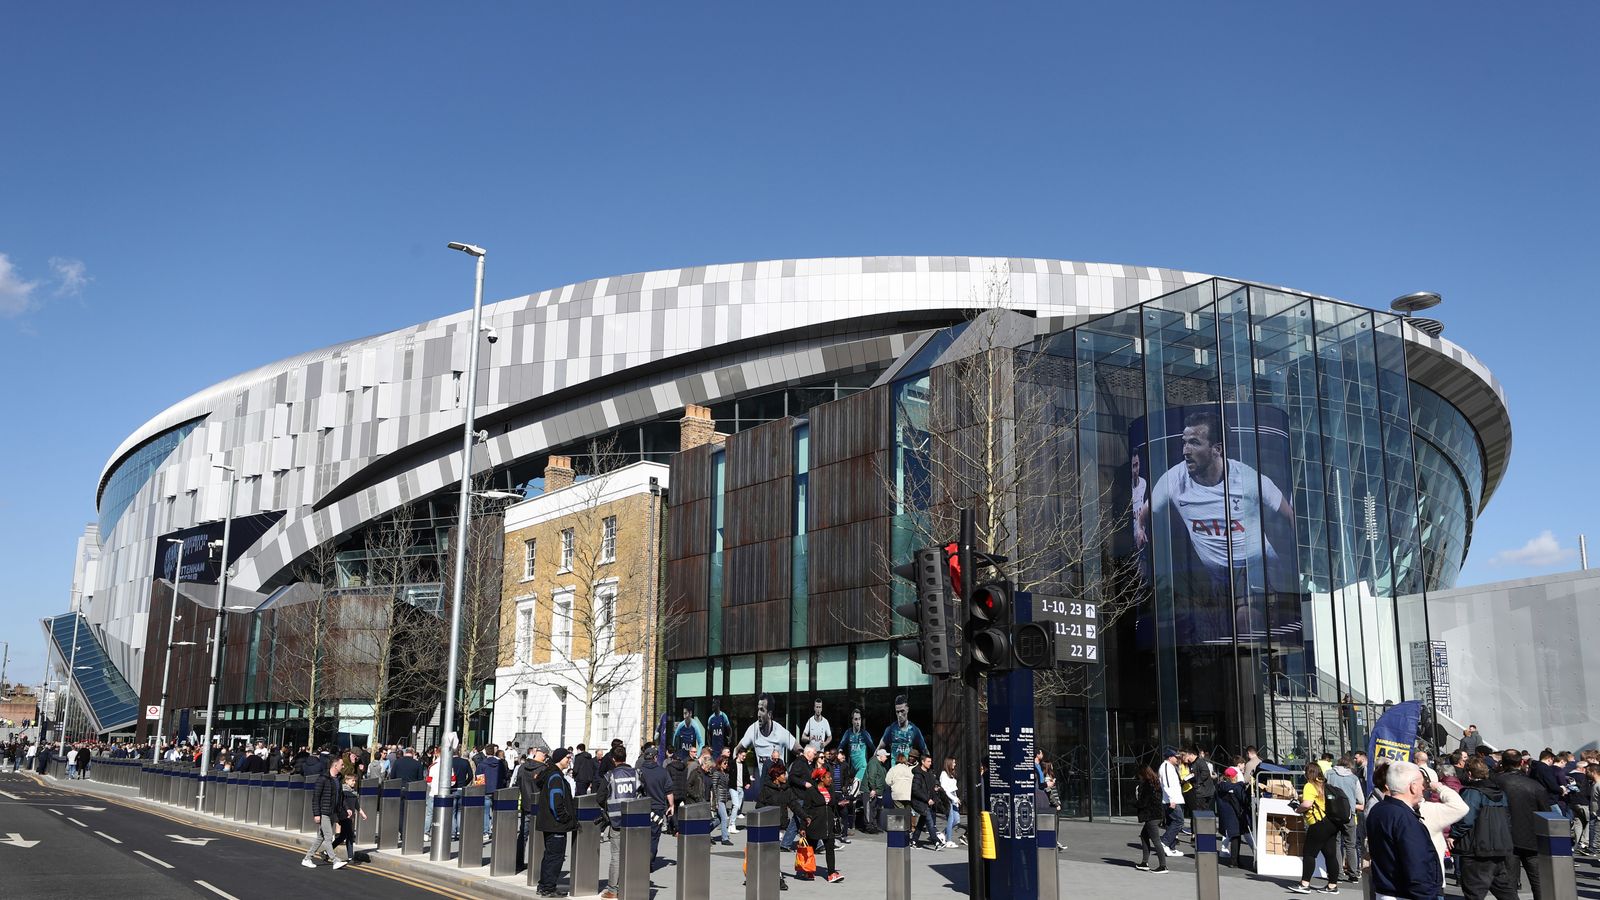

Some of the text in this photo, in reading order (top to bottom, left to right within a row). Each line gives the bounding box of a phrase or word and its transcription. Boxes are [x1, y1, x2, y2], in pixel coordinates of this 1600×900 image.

[1192, 519, 1246, 537] AIA
[1042, 599, 1082, 616] 1-10, 23
[1055, 622, 1083, 637] 11-21
[1070, 644, 1083, 657] 22
[712, 728, 723, 736] AIA
[1377, 747, 1407, 762] ASK
[617, 783, 633, 794] 004
